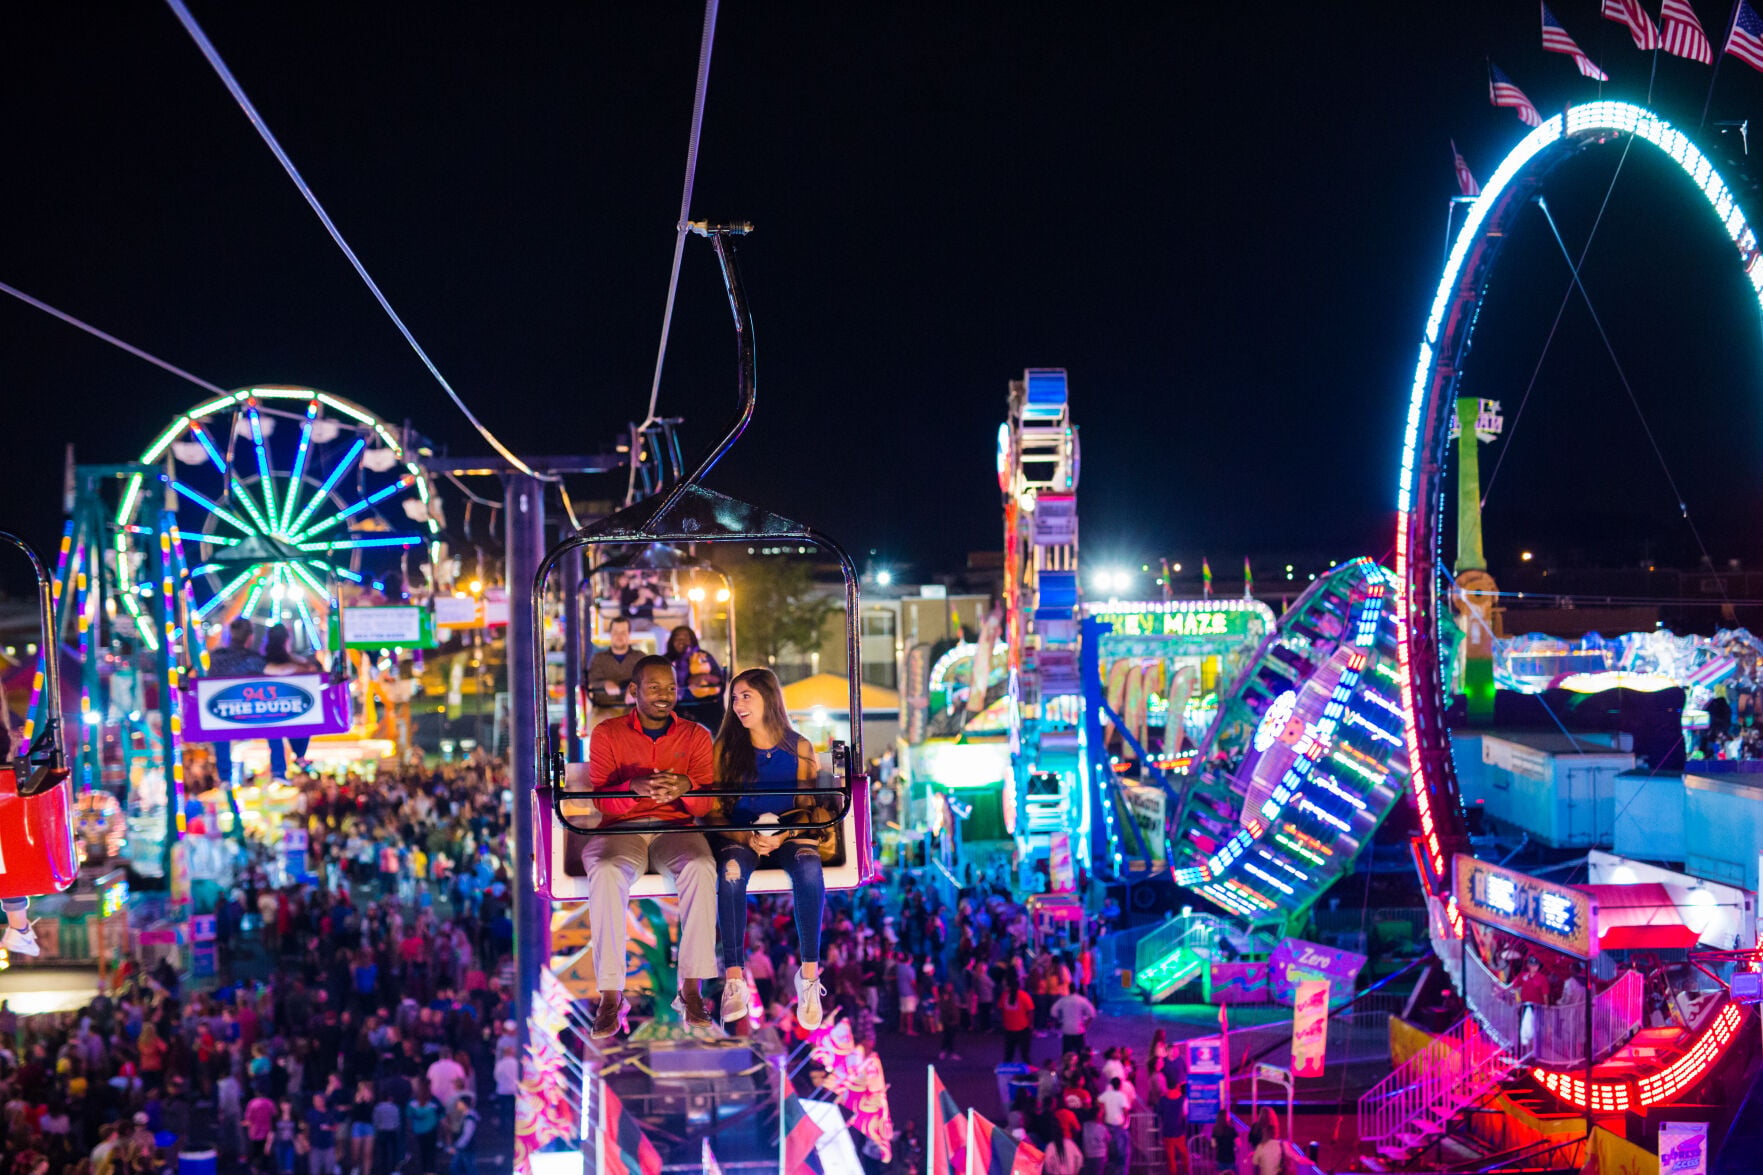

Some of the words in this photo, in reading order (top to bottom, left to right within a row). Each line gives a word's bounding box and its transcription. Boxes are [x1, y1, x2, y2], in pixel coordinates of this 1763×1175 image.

[1163, 612, 1228, 635] MAZE
[217, 701, 253, 717] THE
[254, 699, 303, 714] DUDE
[1298, 946, 1331, 969] Zero
